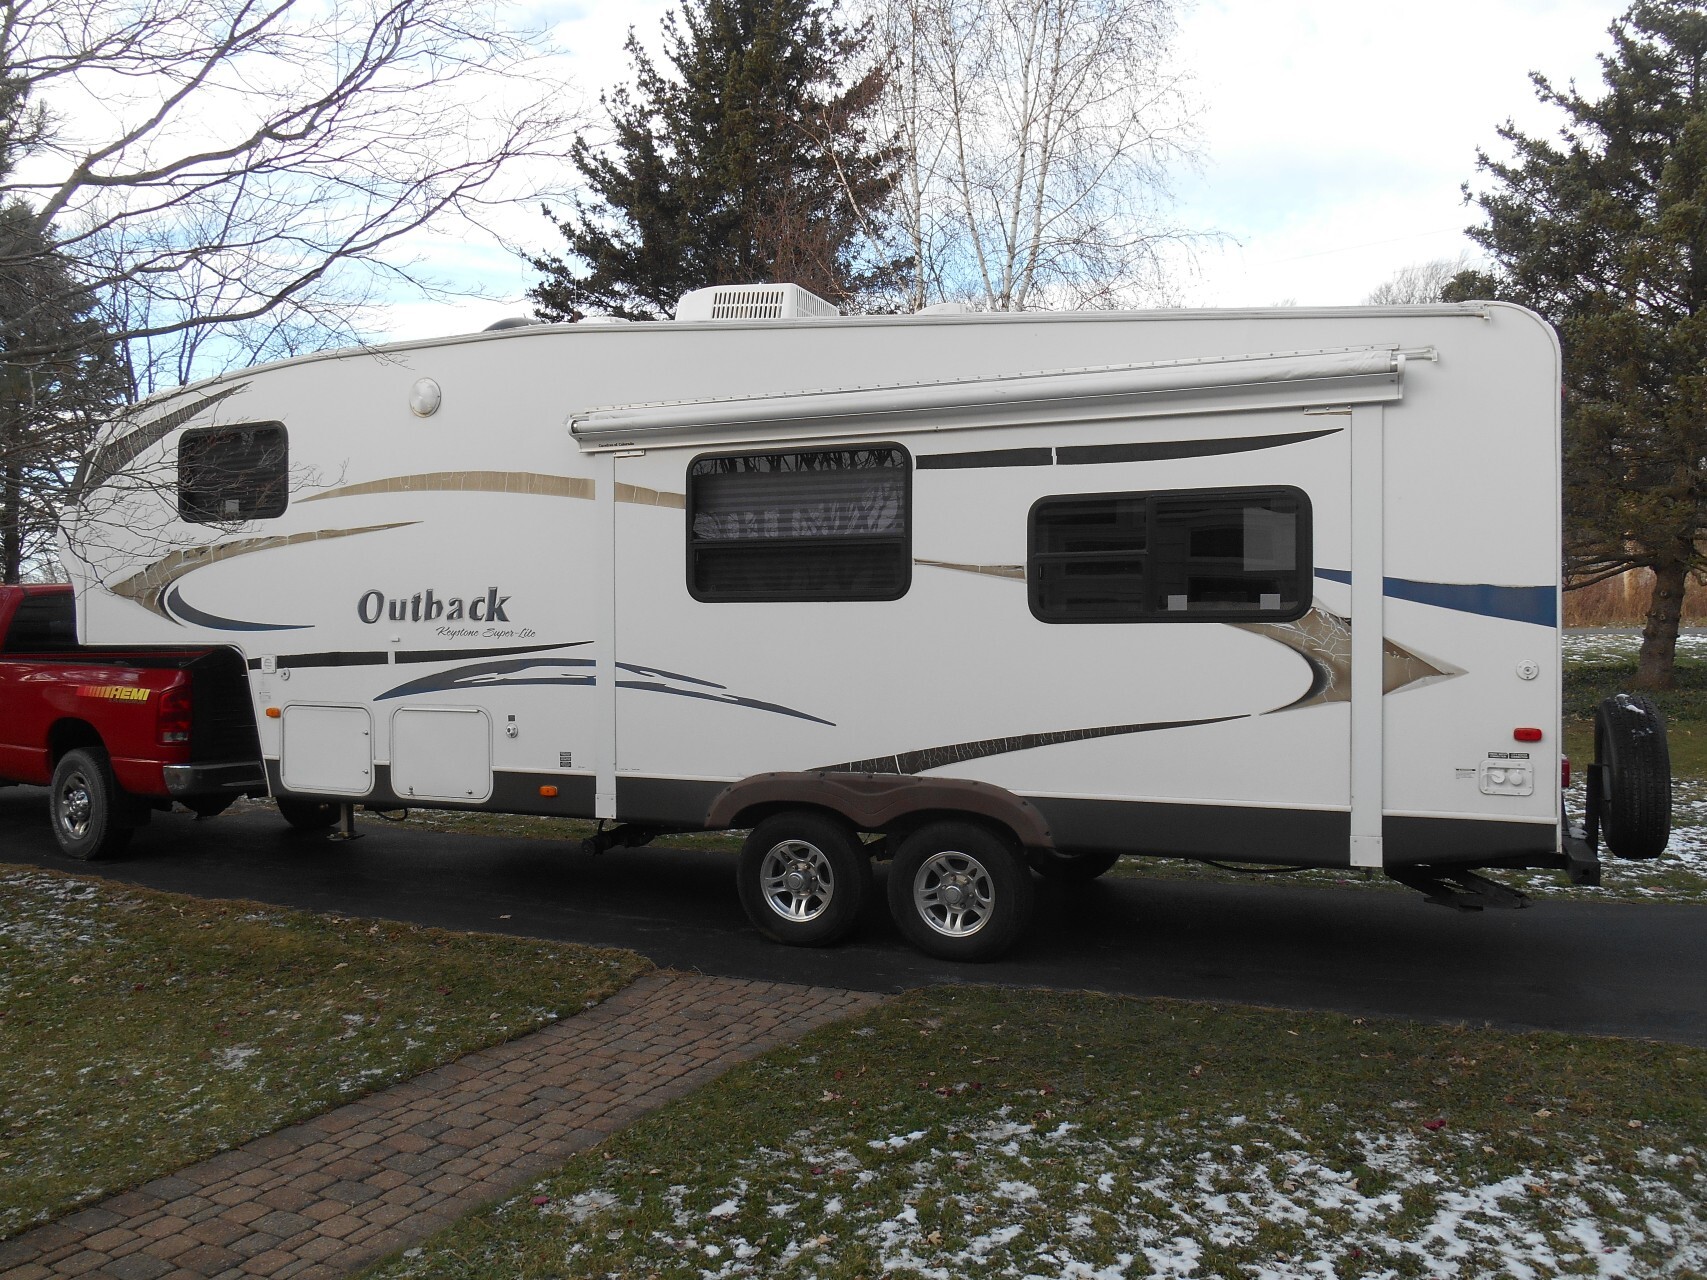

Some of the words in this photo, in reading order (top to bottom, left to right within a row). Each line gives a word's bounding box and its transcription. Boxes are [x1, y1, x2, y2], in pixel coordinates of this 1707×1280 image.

[357, 586, 512, 624] Outback
[435, 625, 479, 641] Keystone
[482, 627, 536, 640] Super-Lite
